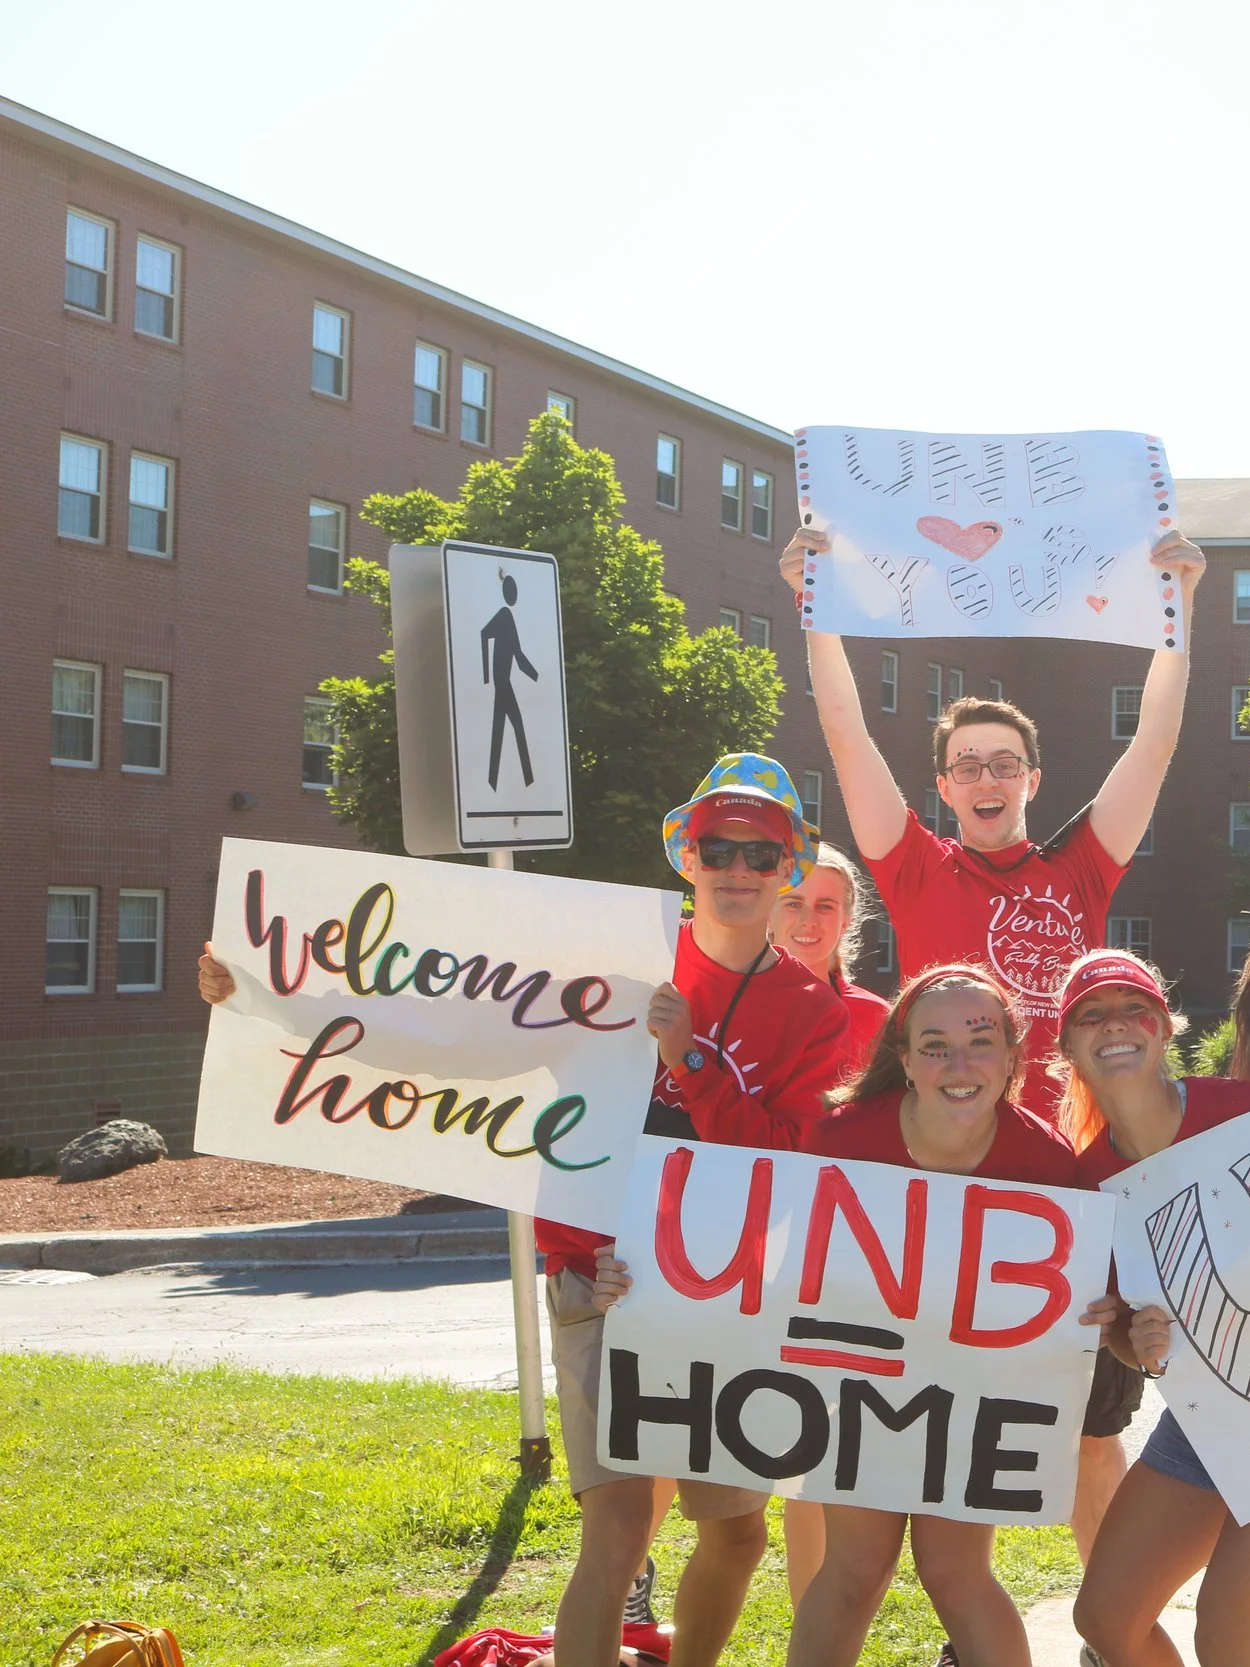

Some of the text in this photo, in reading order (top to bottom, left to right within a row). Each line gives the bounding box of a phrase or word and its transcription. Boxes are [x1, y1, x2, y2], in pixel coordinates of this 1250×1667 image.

[844, 433, 1087, 508] UNB
[715, 798, 762, 808] Canada
[989, 894, 1085, 946] Ventue
[1082, 965, 1134, 980] Canada
[280, 1016, 611, 1171] home
[654, 1146, 1075, 1349] UNB
[609, 1348, 1059, 1513] HOME
